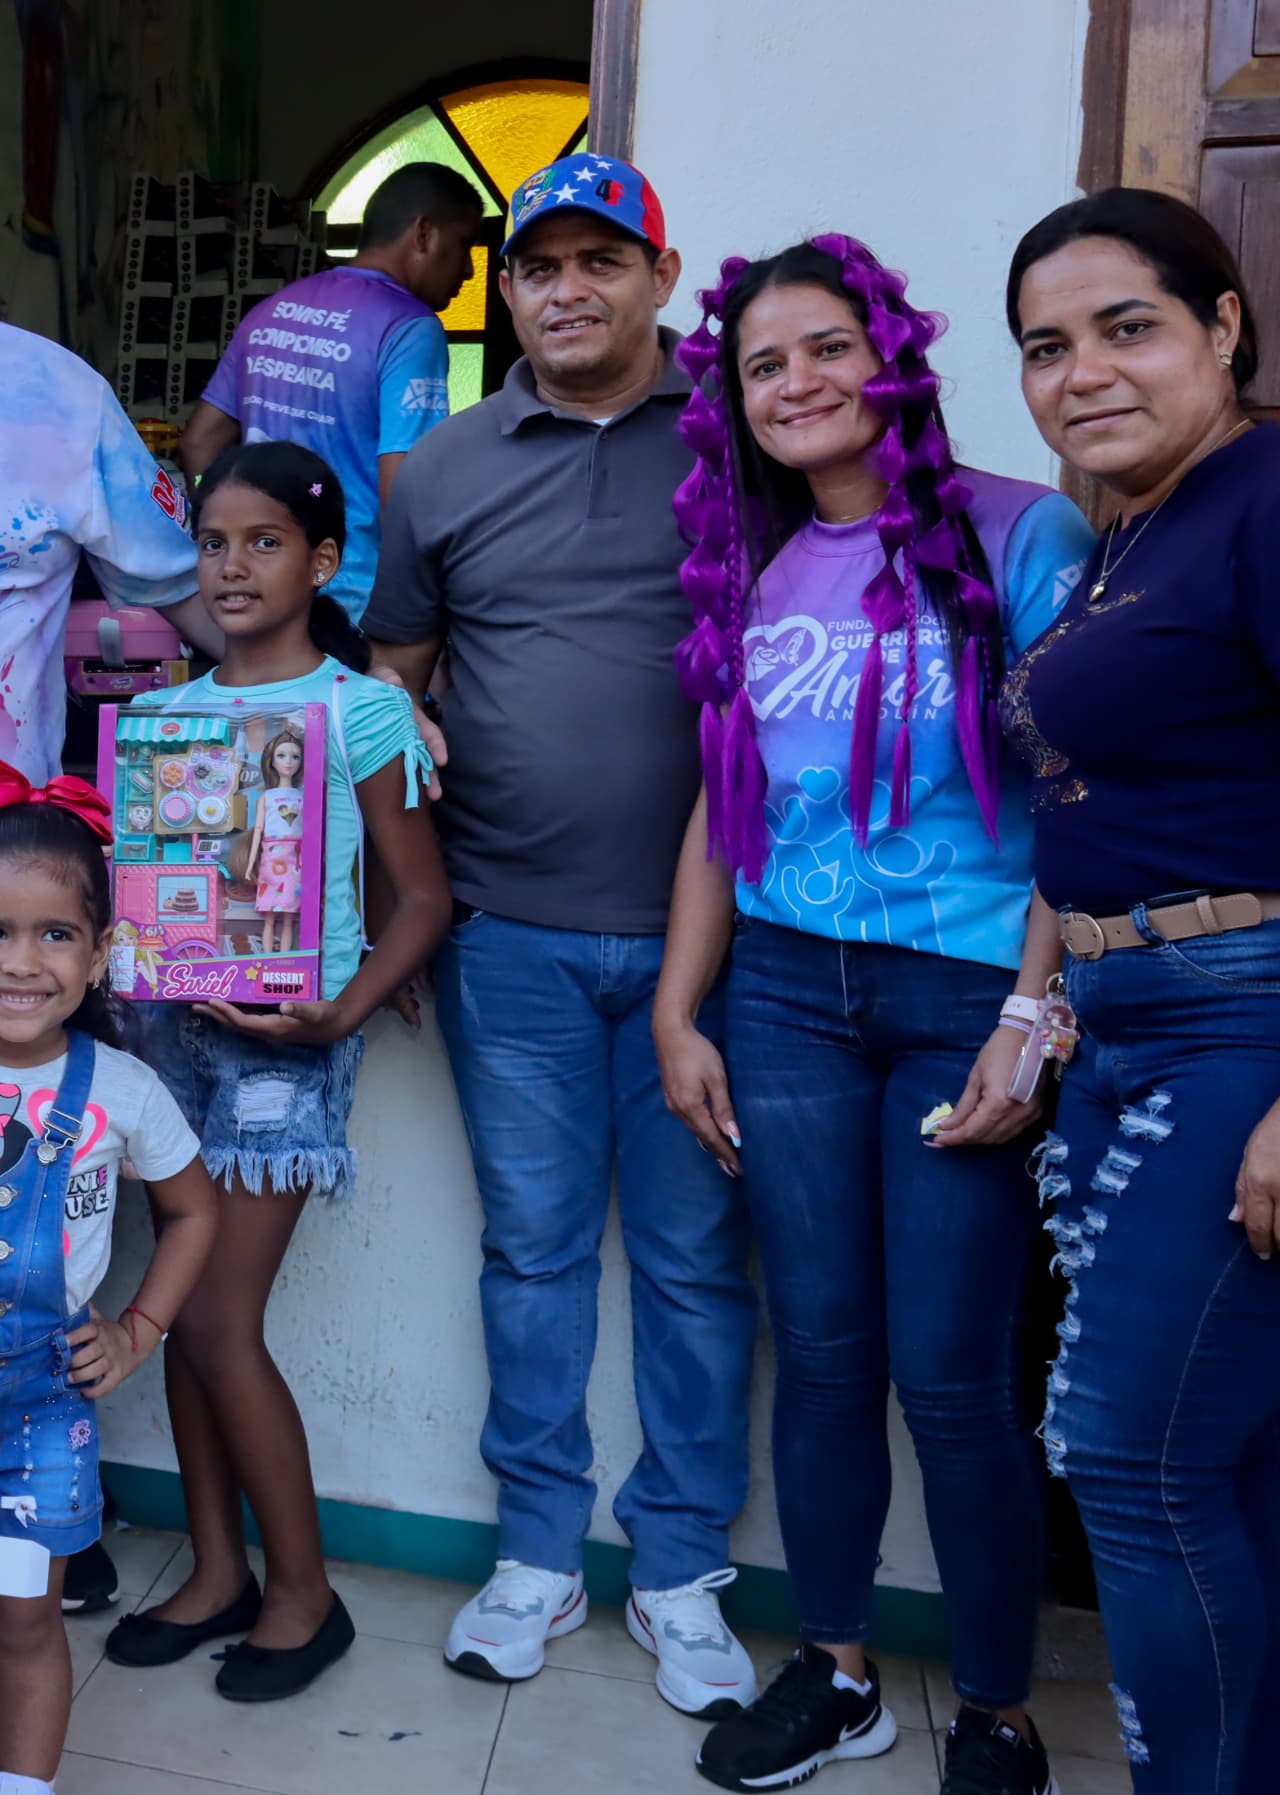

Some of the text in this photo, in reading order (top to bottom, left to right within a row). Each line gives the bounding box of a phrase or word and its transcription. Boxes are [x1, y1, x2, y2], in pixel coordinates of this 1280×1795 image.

[827, 619, 873, 633] FUNDA
[163, 962, 238, 998] Sariel
[262, 971, 305, 984] DESSERT
[263, 983, 304, 994] SHOP
